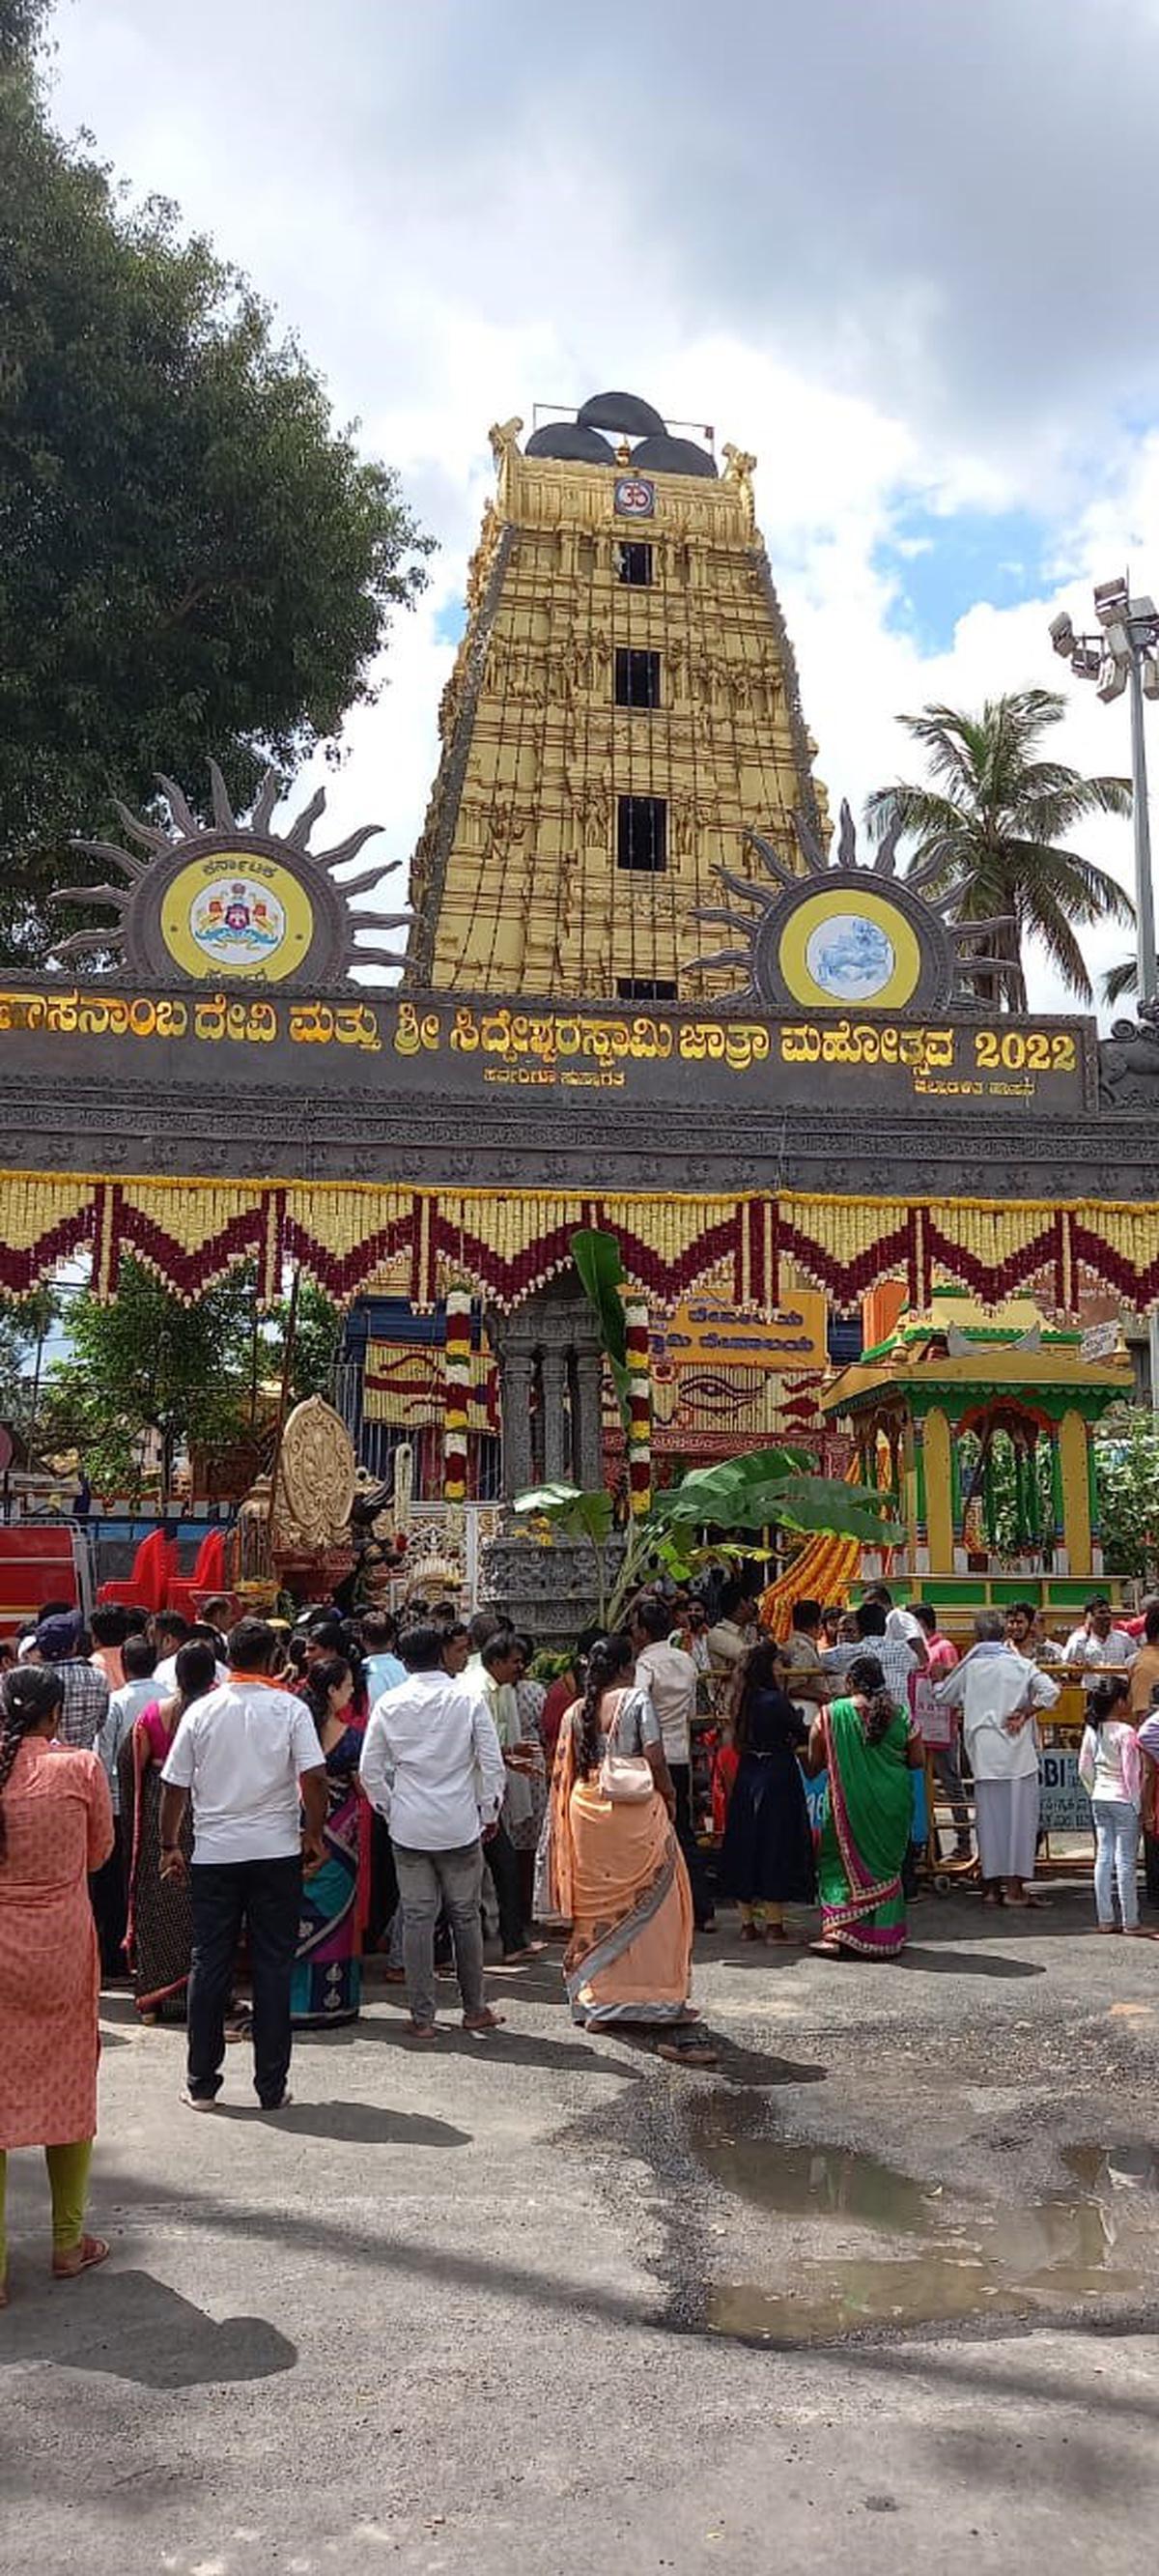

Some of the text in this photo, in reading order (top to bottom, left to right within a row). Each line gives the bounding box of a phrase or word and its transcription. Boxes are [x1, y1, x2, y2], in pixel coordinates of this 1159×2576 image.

[195, 993, 276, 1043] ದೇವಿ
[291, 1001, 382, 1051] ಮತ್ತು
[394, 1002, 438, 1055] ಶ್ರೀ
[679, 1023, 770, 1070] ಜಾತ್ರಾ
[780, 1019, 953, 1075] ಮಹೋತ್ಸವ
[975, 1031, 1076, 1072] 2022
[1038, 1759, 1065, 1788] BI
